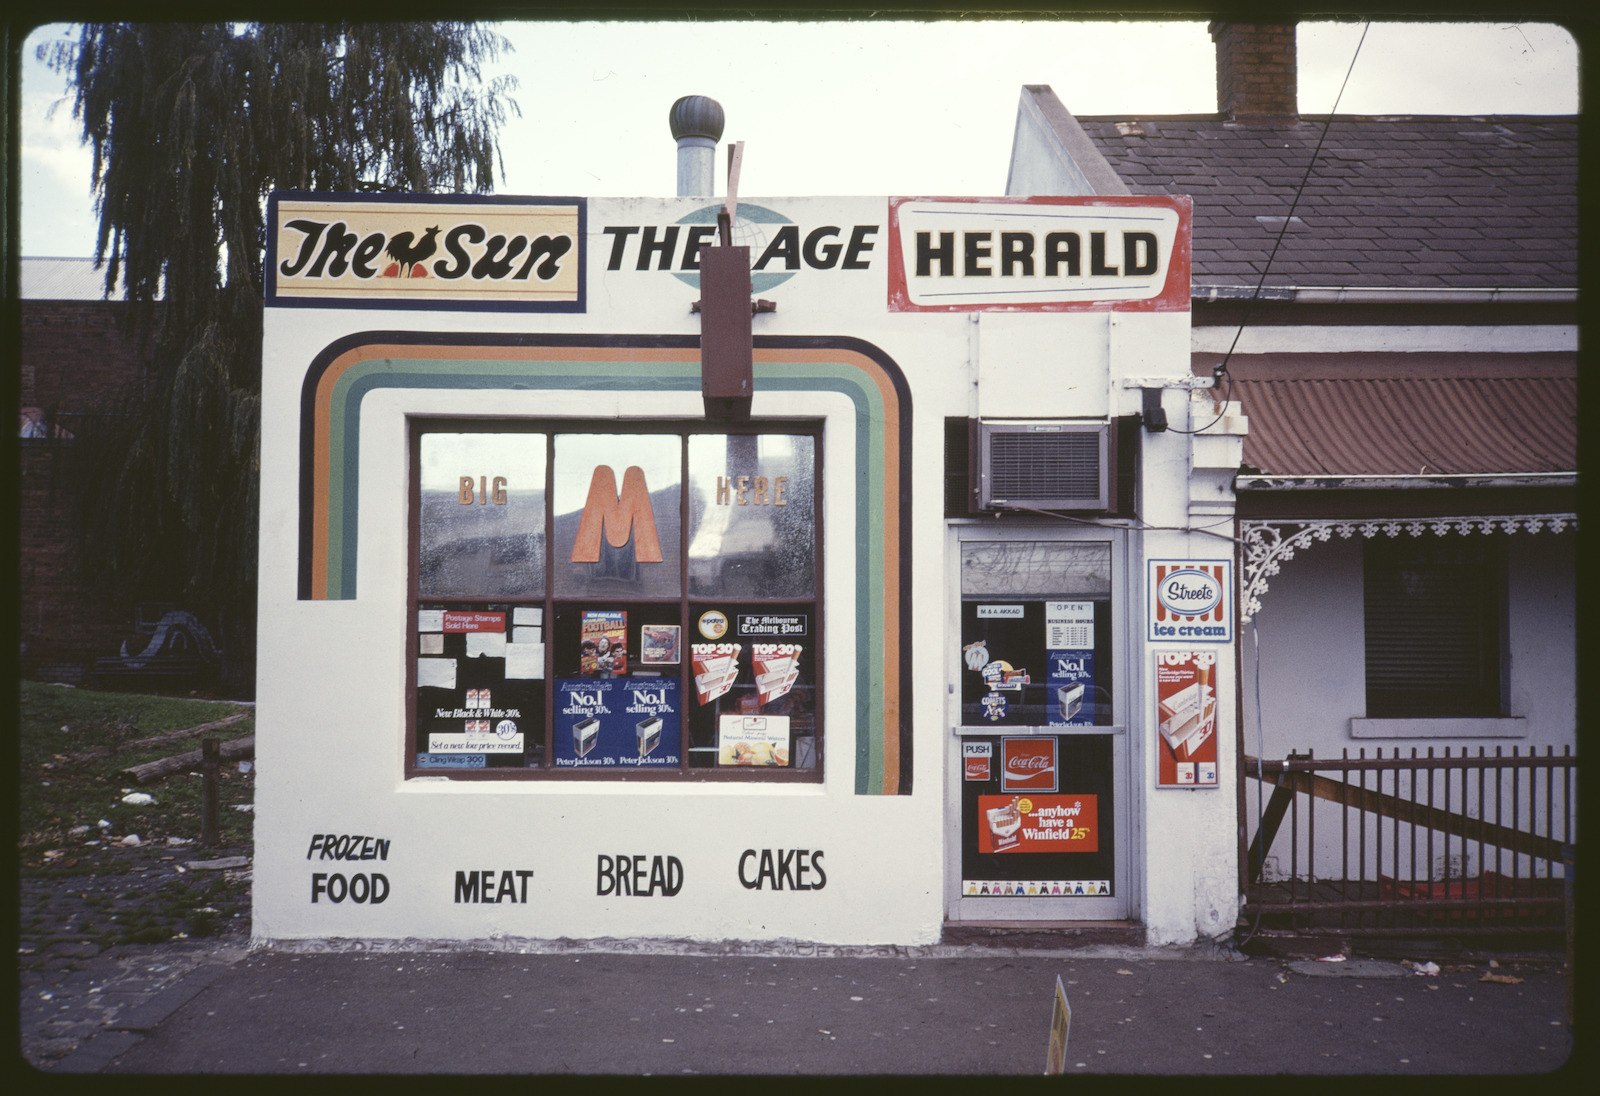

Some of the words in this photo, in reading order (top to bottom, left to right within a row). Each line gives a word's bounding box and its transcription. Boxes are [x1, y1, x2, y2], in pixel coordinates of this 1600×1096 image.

[280, 219, 386, 278] The
[433, 224, 572, 281] Sun
[603, 226, 717, 270] THE
[751, 225, 879, 271] AGE
[915, 231, 1160, 278] HERALD
[458, 476, 507, 505] BIG
[571, 464, 663, 563] M
[717, 476, 788, 506] HERE
[1168, 581, 1213, 600] Streets
[582, 619, 626, 632] FOOTBALL
[761, 616, 798, 624] Melbourne
[741, 624, 779, 634] Trading
[781, 624, 803, 634] Post
[1154, 622, 1175, 636] ice
[1178, 624, 1226, 636] cream
[691, 643, 716, 654] TOP
[716, 643, 734, 654] 30
[752, 643, 777, 654] TOP
[777, 643, 795, 654] 30
[1050, 651, 1092, 660] Australia's
[1158, 652, 1192, 665] TOP
[1192, 652, 1216, 665] 30
[1058, 658, 1084, 671] No.1
[1052, 671, 1077, 680] selling
[560, 681, 613, 691] Australia's
[623, 680, 675, 690] Australia's
[570, 690, 603, 705] No.1
[633, 689, 666, 704] No.1
[435, 708, 452, 718] New
[452, 708, 474, 718] Black
[475, 708, 482, 718] &
[483, 708, 505, 718] White
[563, 705, 594, 717] selling
[626, 704, 657, 716] selling
[496, 722, 516, 736] 30's
[1199, 720, 1212, 740] 30
[477, 742, 495, 751] price
[966, 745, 990, 753] PUSH
[429, 756, 446, 765] Cling
[447, 756, 466, 765] Wrap
[466, 756, 484, 764] 300
[1008, 755, 1050, 769] Coca-Cola
[1039, 817, 1064, 827] have
[1066, 819, 1074, 827] a
[1022, 828, 1069, 840] Winfield
[307, 833, 390, 860] FROZEN
[596, 854, 684, 897] BREAD
[737, 848, 827, 891] CAKES
[311, 873, 390, 904] FOOD
[454, 870, 533, 904] MEAT
